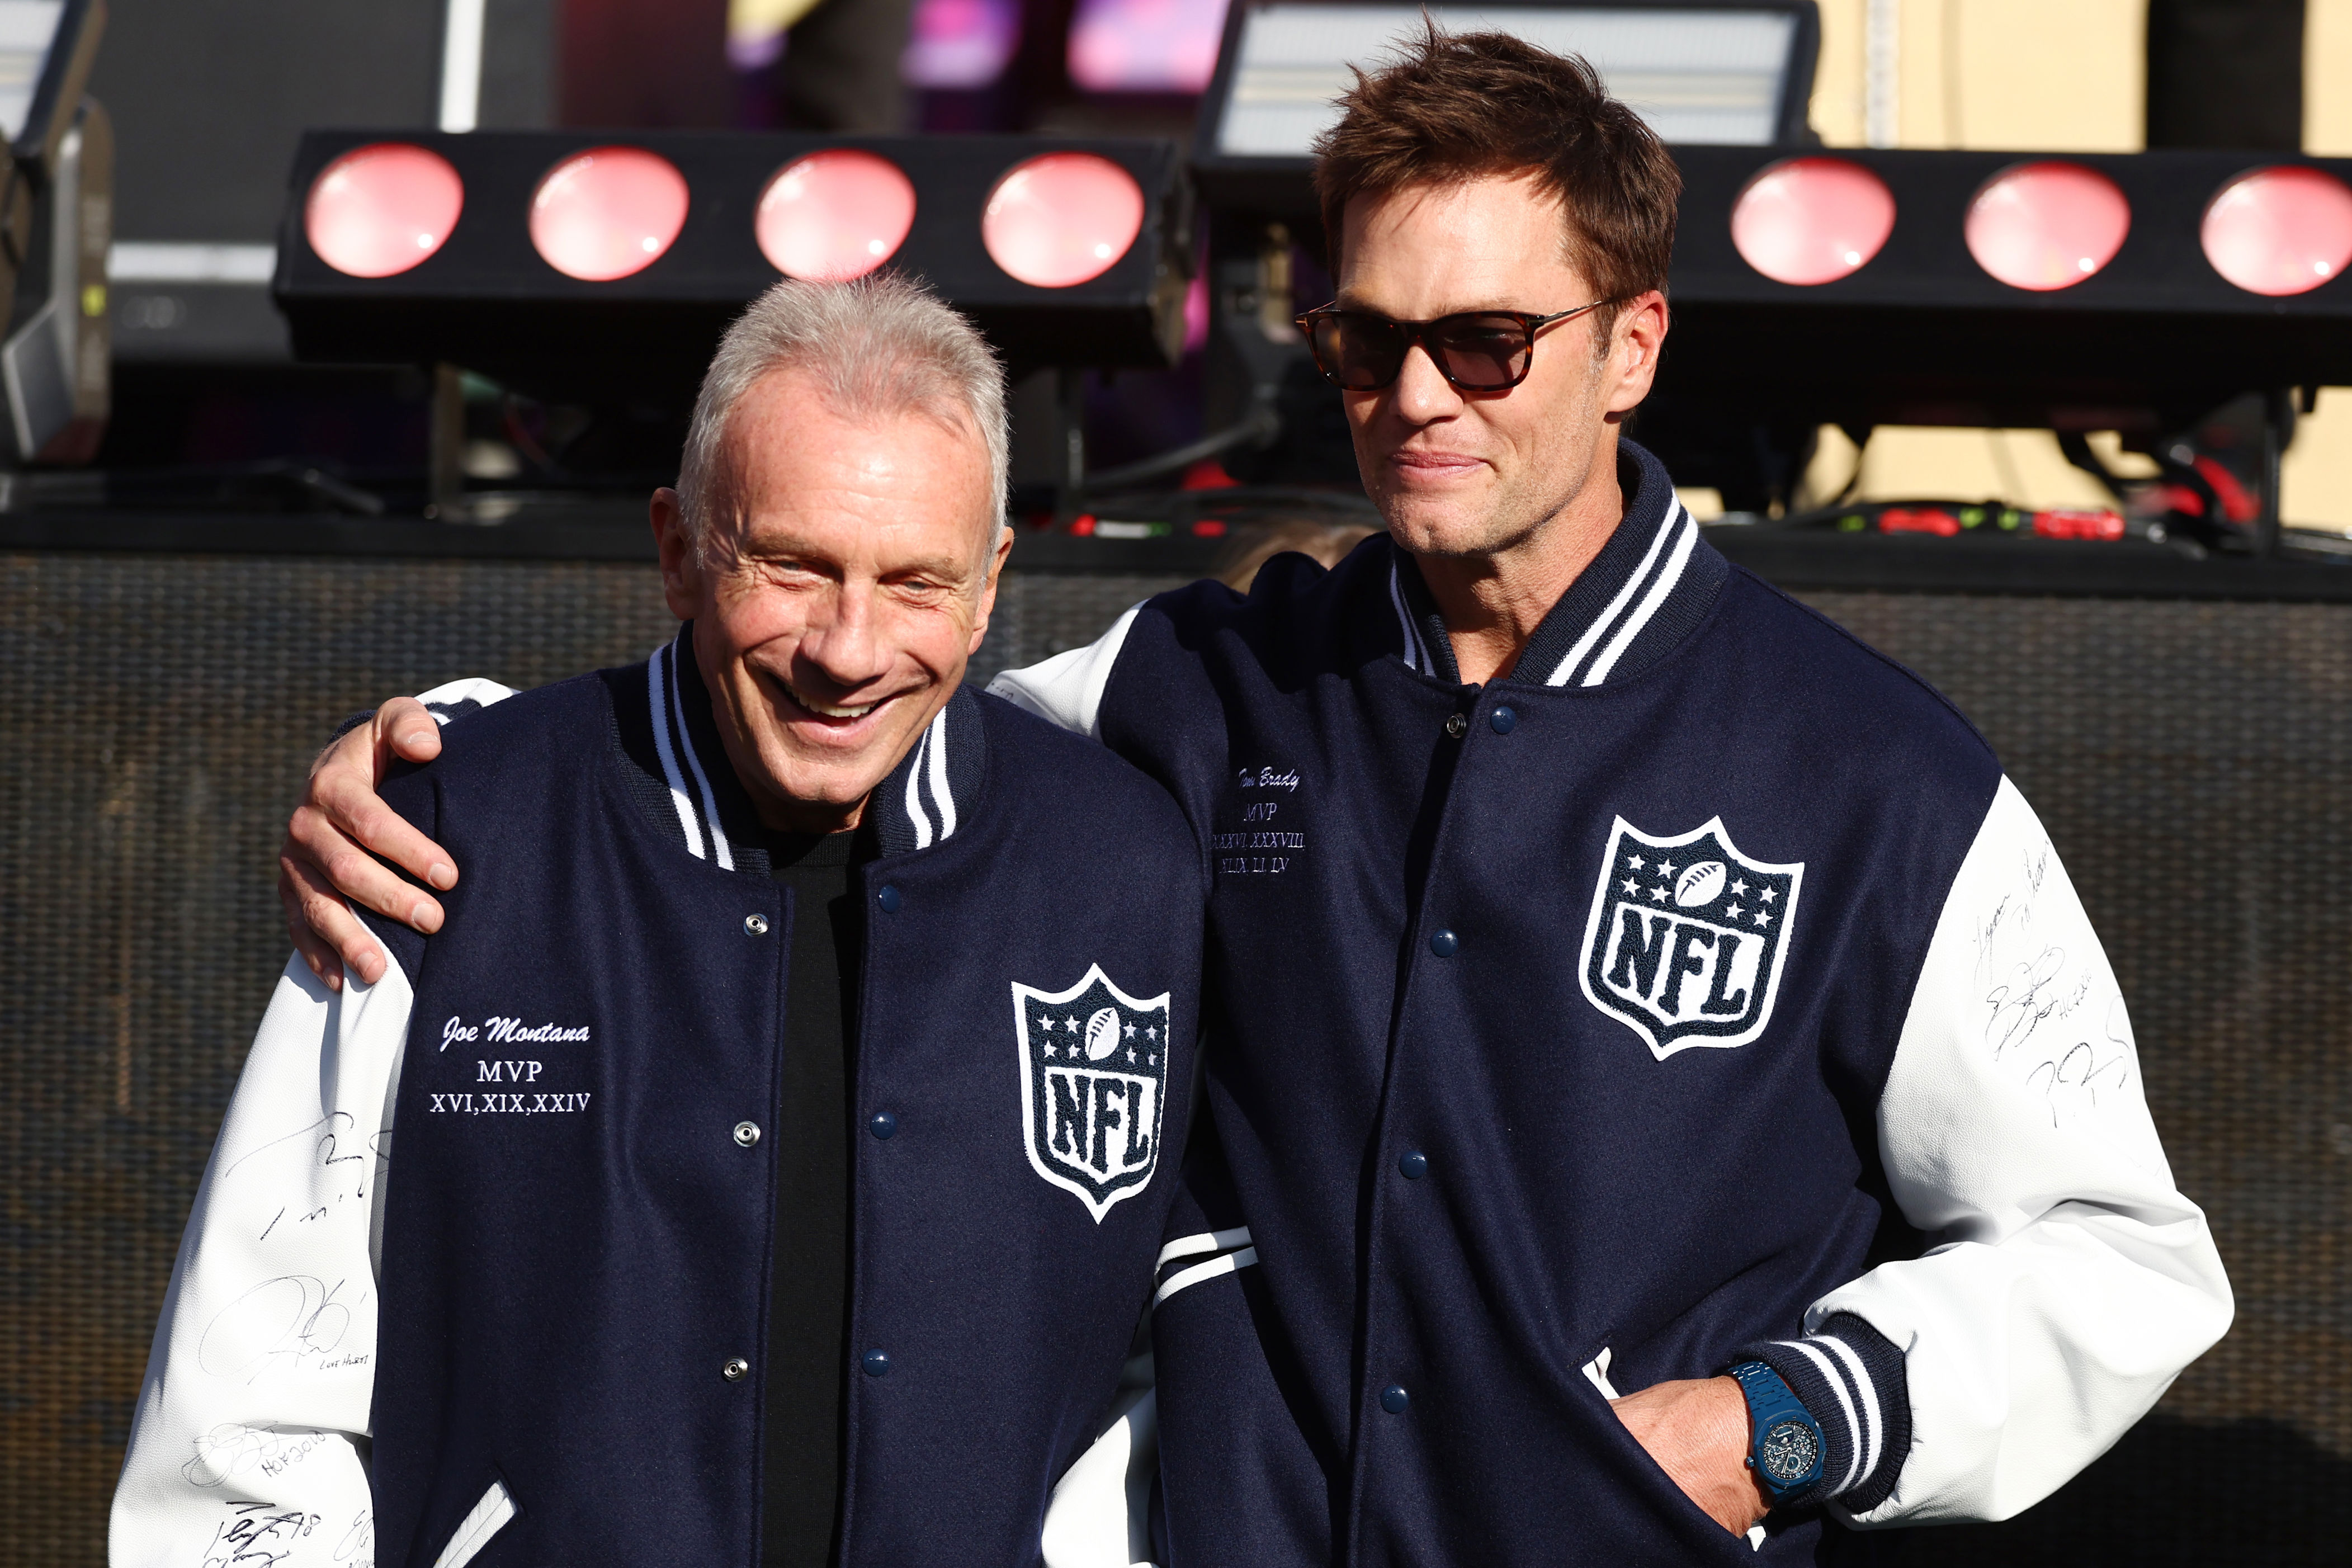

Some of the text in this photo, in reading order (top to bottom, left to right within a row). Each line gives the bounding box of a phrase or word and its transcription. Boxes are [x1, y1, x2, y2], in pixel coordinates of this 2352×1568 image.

[1259, 766, 1300, 792] Brady
[1243, 802, 1277, 821] MVP
[1607, 908, 1746, 1018] NFL
[440, 1016, 591, 1052] Joe Montana
[476, 1060, 543, 1082] MVP
[1049, 1073, 1150, 1174] NFL
